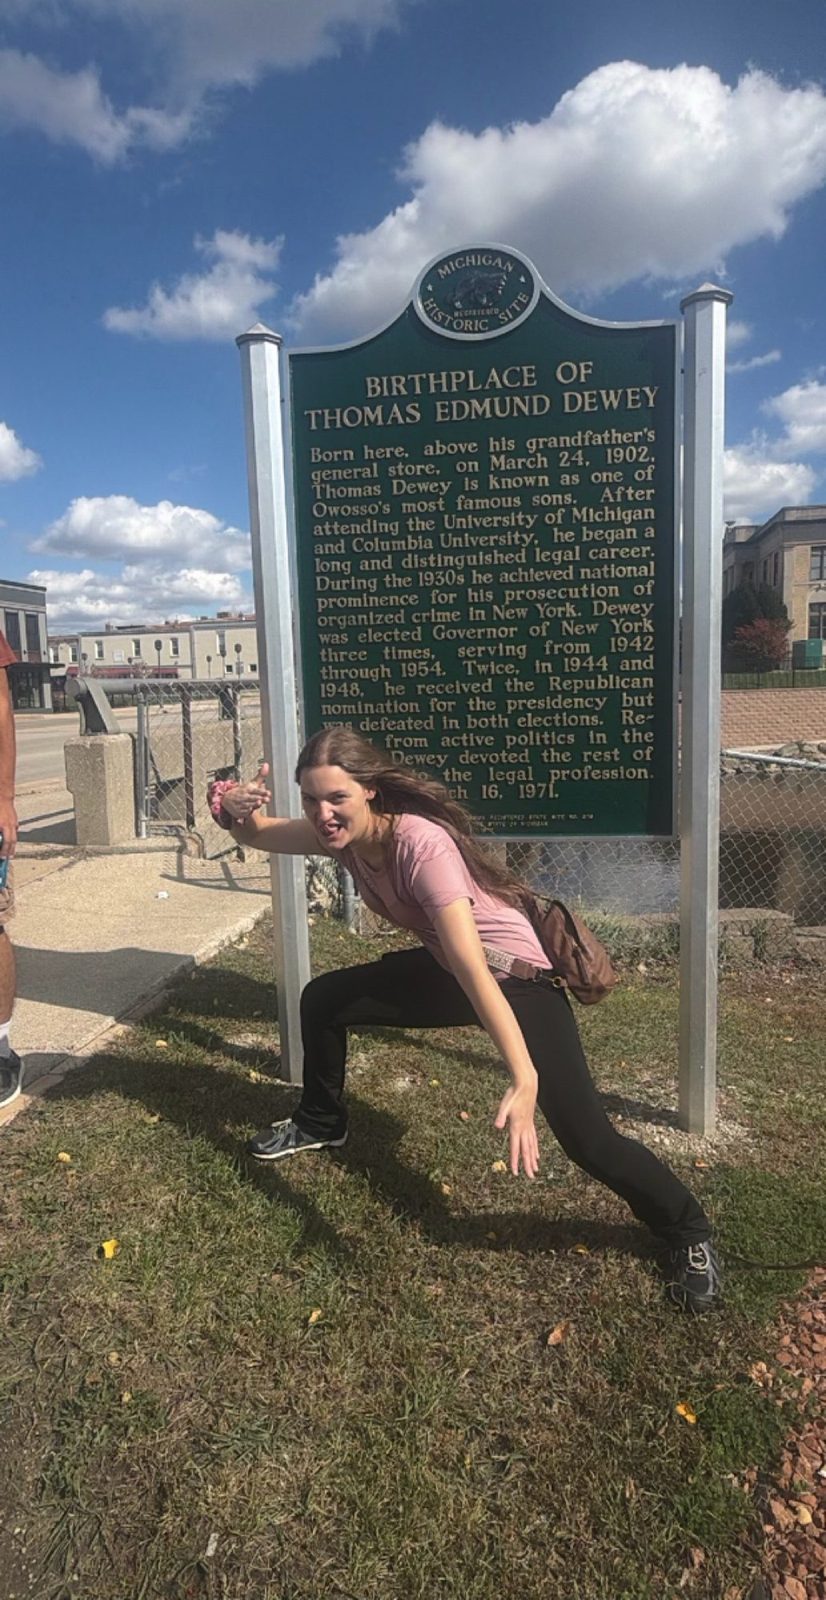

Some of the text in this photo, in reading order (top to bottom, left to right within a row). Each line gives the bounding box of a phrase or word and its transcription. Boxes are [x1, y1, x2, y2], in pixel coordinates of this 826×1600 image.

[438, 254, 514, 278] MICHIGAN
[424, 293, 529, 331] HISTORIC SITE
[366, 362, 593, 398] BIRTHPLACE OF
[305, 387, 659, 430] THOMAS EDMUND DEWEY
[311, 447, 353, 463] Born
[424, 440, 477, 455] above
[490, 438, 514, 452] his
[527, 429, 654, 452] grandfather's
[311, 463, 378, 484] general
[388, 461, 440, 476] store,
[456, 460, 478, 472] on
[490, 453, 548, 471] March
[559, 450, 590, 466] 24,
[312, 466, 654, 498] Thomas Dewey is known as one of
[313, 488, 654, 518] Owosso's most famous sons. After
[314, 506, 654, 536] attending the University of Michigan
[314, 539, 344, 554] and
[353, 535, 433, 553] Columbia
[554, 529, 575, 542] he
[582, 526, 636, 545] began
[645, 526, 654, 539] a
[315, 545, 654, 575] long and distinguished legal career.
[316, 562, 654, 592] During the 1930s he achieved national
[317, 581, 654, 612] prominence for his prosecution of
[318, 600, 653, 629] organized crime in New York. Dewey
[319, 618, 654, 644] was elected Governor of New York
[321, 637, 654, 662] three times, serving from 1942
[321, 655, 653, 681] through 1954. Twice, in 1944 and
[321, 674, 653, 697] 1948, he received the Republican
[322, 691, 653, 714] nomination for the presidency but
[323, 720, 352, 731] was
[361, 714, 433, 730] defeated
[442, 714, 459, 729] in
[467, 712, 508, 728] both
[517, 712, 604, 726] elections.
[386, 733, 428, 748] from
[441, 731, 494, 746] active
[505, 730, 575, 746] politics
[589, 728, 606, 743] in
[622, 726, 653, 742] the
[392, 746, 653, 767] Dewey devoted the rest of
[443, 768, 472, 781] the
[489, 766, 533, 784] legal
[549, 764, 654, 783] profession.
[481, 784, 502, 799] 16,
[519, 782, 559, 799] 1971.
